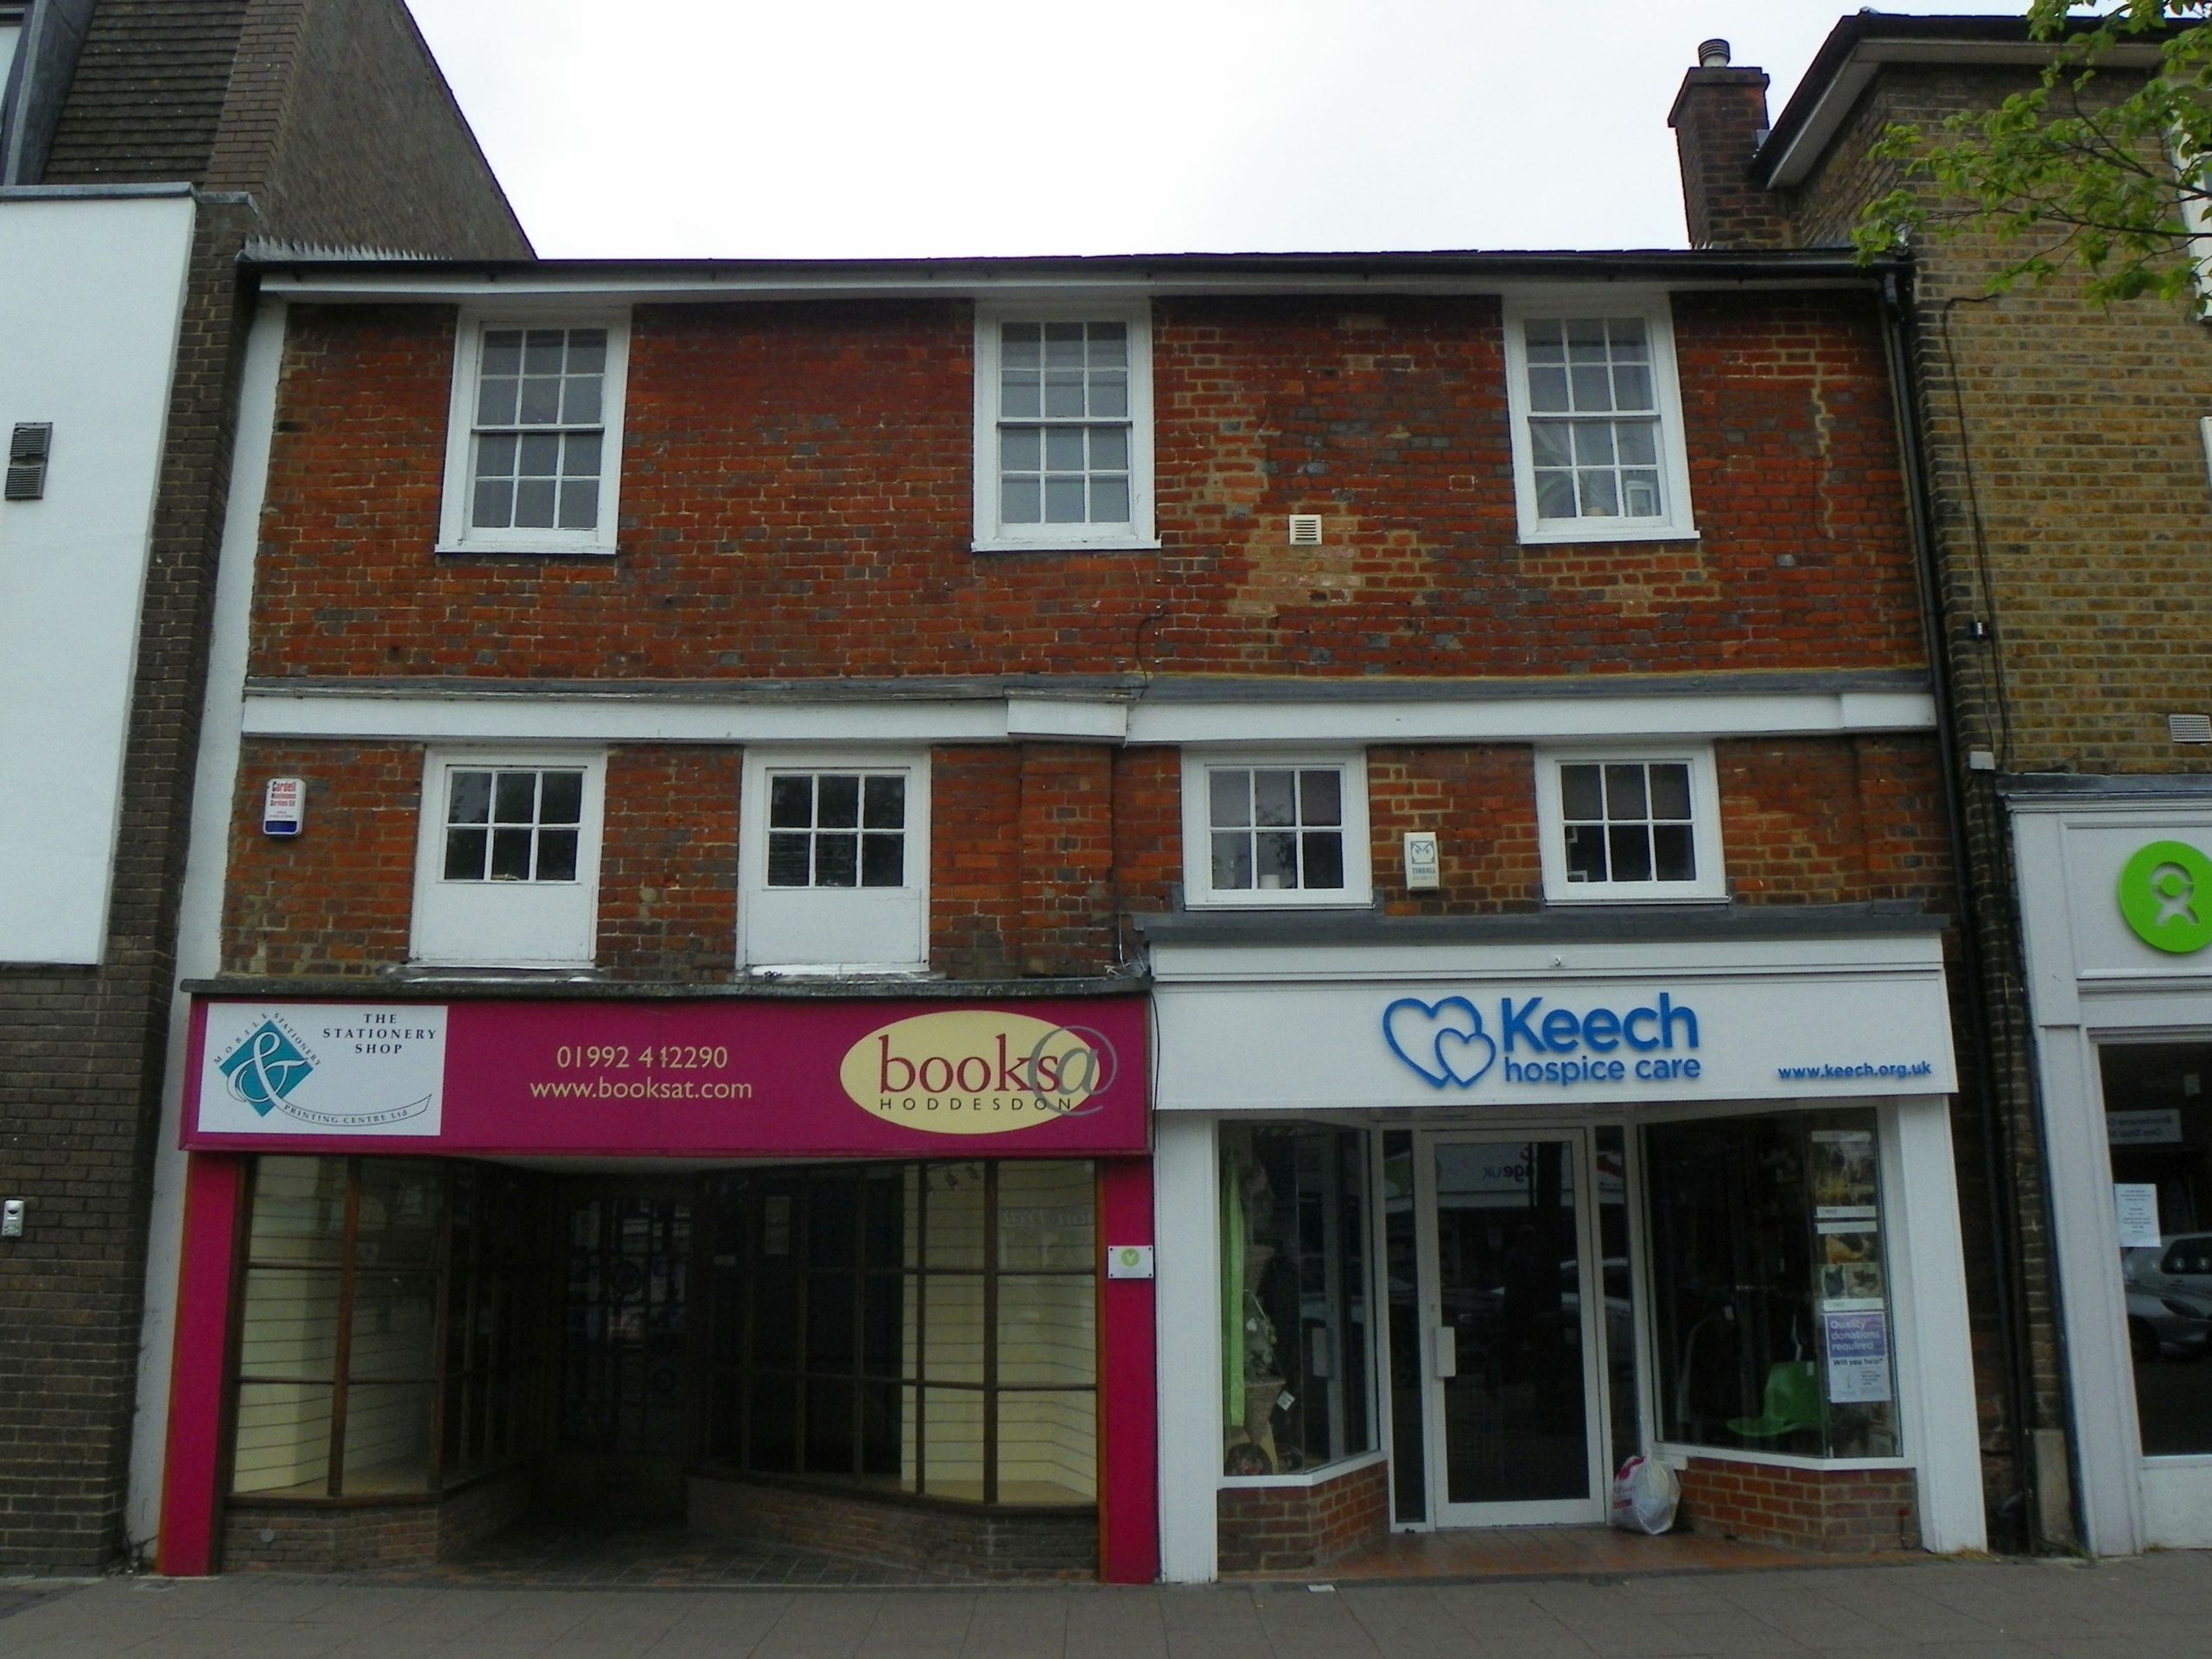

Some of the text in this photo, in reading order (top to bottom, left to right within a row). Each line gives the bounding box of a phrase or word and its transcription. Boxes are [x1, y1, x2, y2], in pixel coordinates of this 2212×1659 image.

[364, 1013, 397, 1024] THE
[1501, 992, 1700, 1053] Keech
[214, 1012, 322, 1066] MOBILE STATIONERY
[322, 1027, 437, 1039] STATIONERY
[355, 1043, 403, 1054] SHOP
[556, 1046, 630, 1068] 01992
[1504, 1055, 1701, 1087] hospice care
[1777, 1060, 1932, 1079] www.keech.org.uk
[530, 1076, 753, 1099] www.booksat.com
[880, 1097, 1071, 1111] HODDESDON
[283, 1104, 408, 1124] PRINTING CENTRE Ltd
[1830, 1318, 1866, 1330] Quality
[1831, 1331, 1882, 1341] donations
[1832, 1341, 1874, 1352] required
[1849, 1358, 1863, 1367] you
